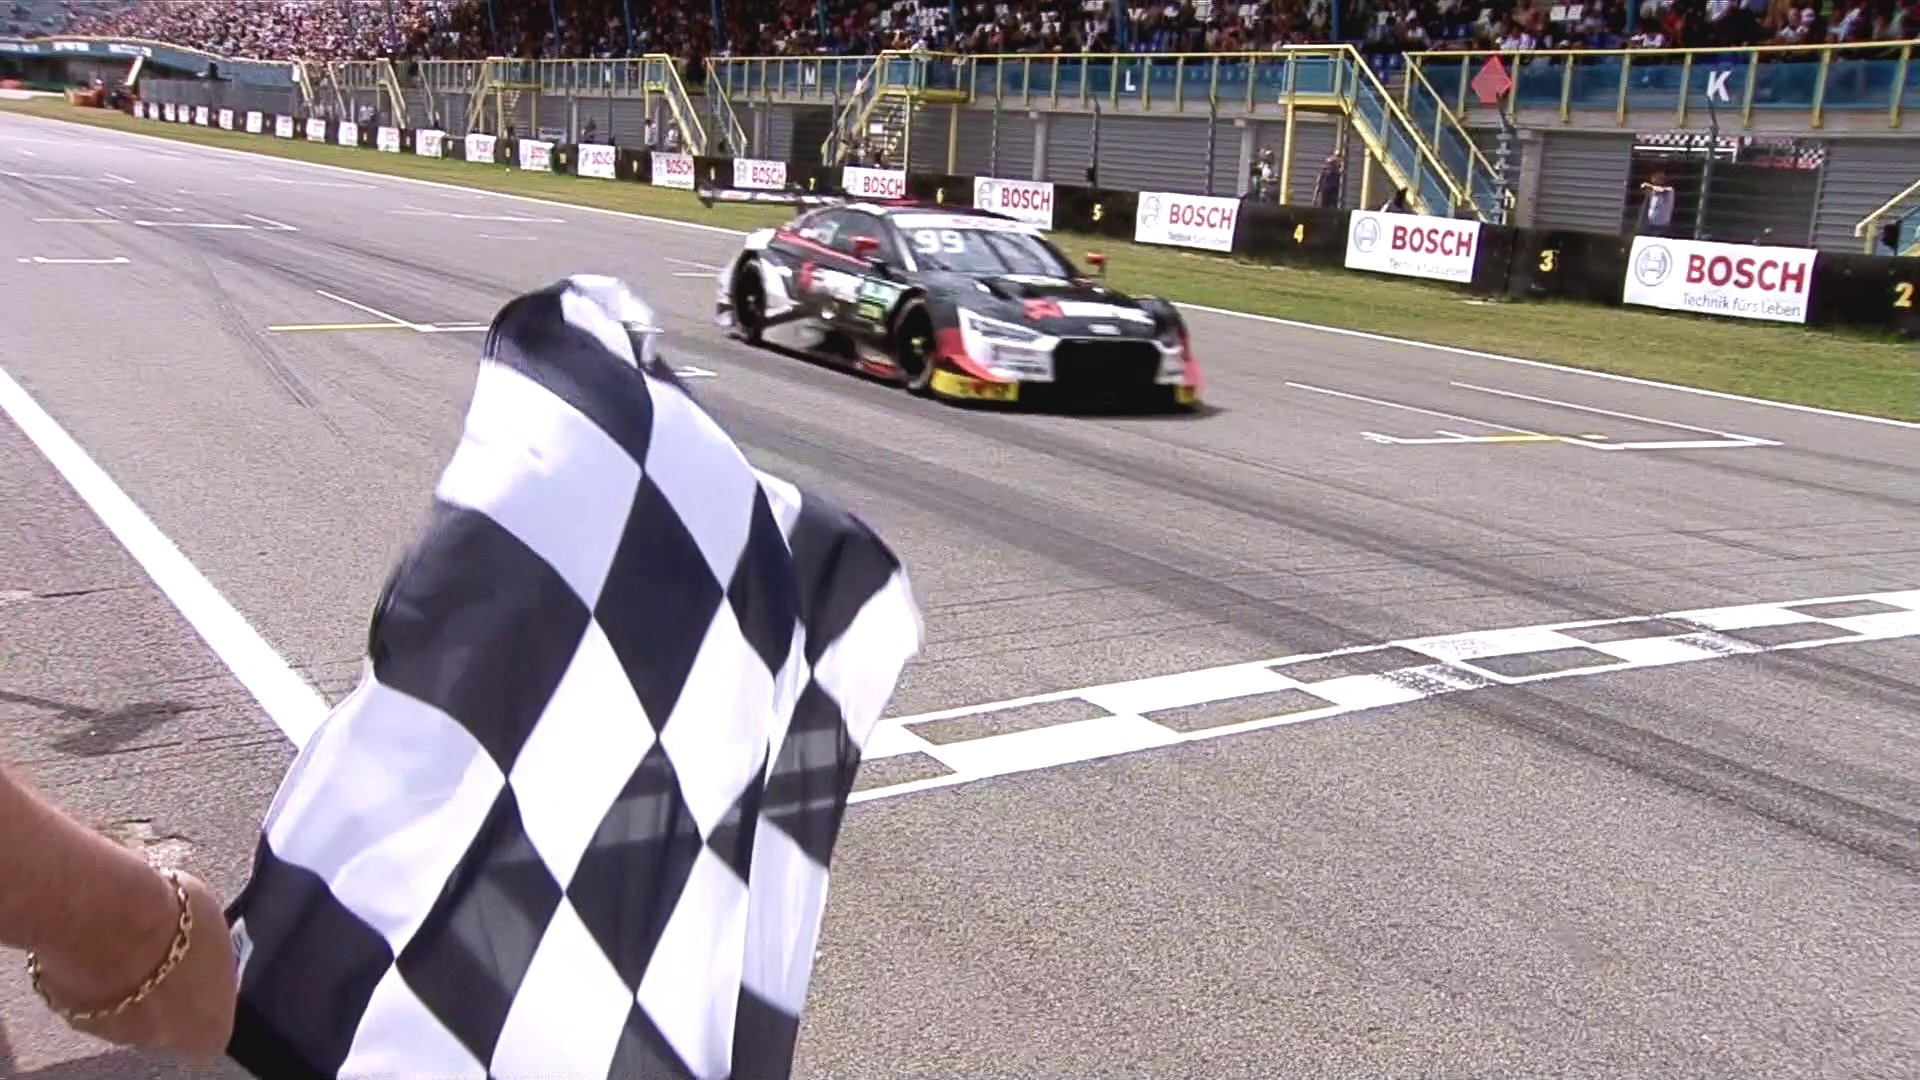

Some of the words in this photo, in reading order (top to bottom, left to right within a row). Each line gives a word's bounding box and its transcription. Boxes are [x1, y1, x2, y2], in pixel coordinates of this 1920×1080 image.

[805, 67, 815, 85] M
[1125, 69, 1137, 92] L
[1706, 70, 1732, 102] K
[752, 166, 785, 186] BOSCH
[863, 176, 903, 198] BOSCH
[1001, 187, 1051, 212] BOSCH
[1092, 203, 1103, 221] 5
[1169, 203, 1234, 230] BOSCH
[914, 229, 965, 254] 99
[1293, 223, 1305, 243] 4
[1391, 225, 1473, 258] BOSCH
[1539, 250, 1555, 272] 3
[1686, 253, 1806, 294] BOSCH
[1683, 292, 1729, 311] Technik
[1732, 297, 1758, 313] fürs
[1761, 299, 1801, 317] Leben
[1894, 282, 1914, 308] 2
